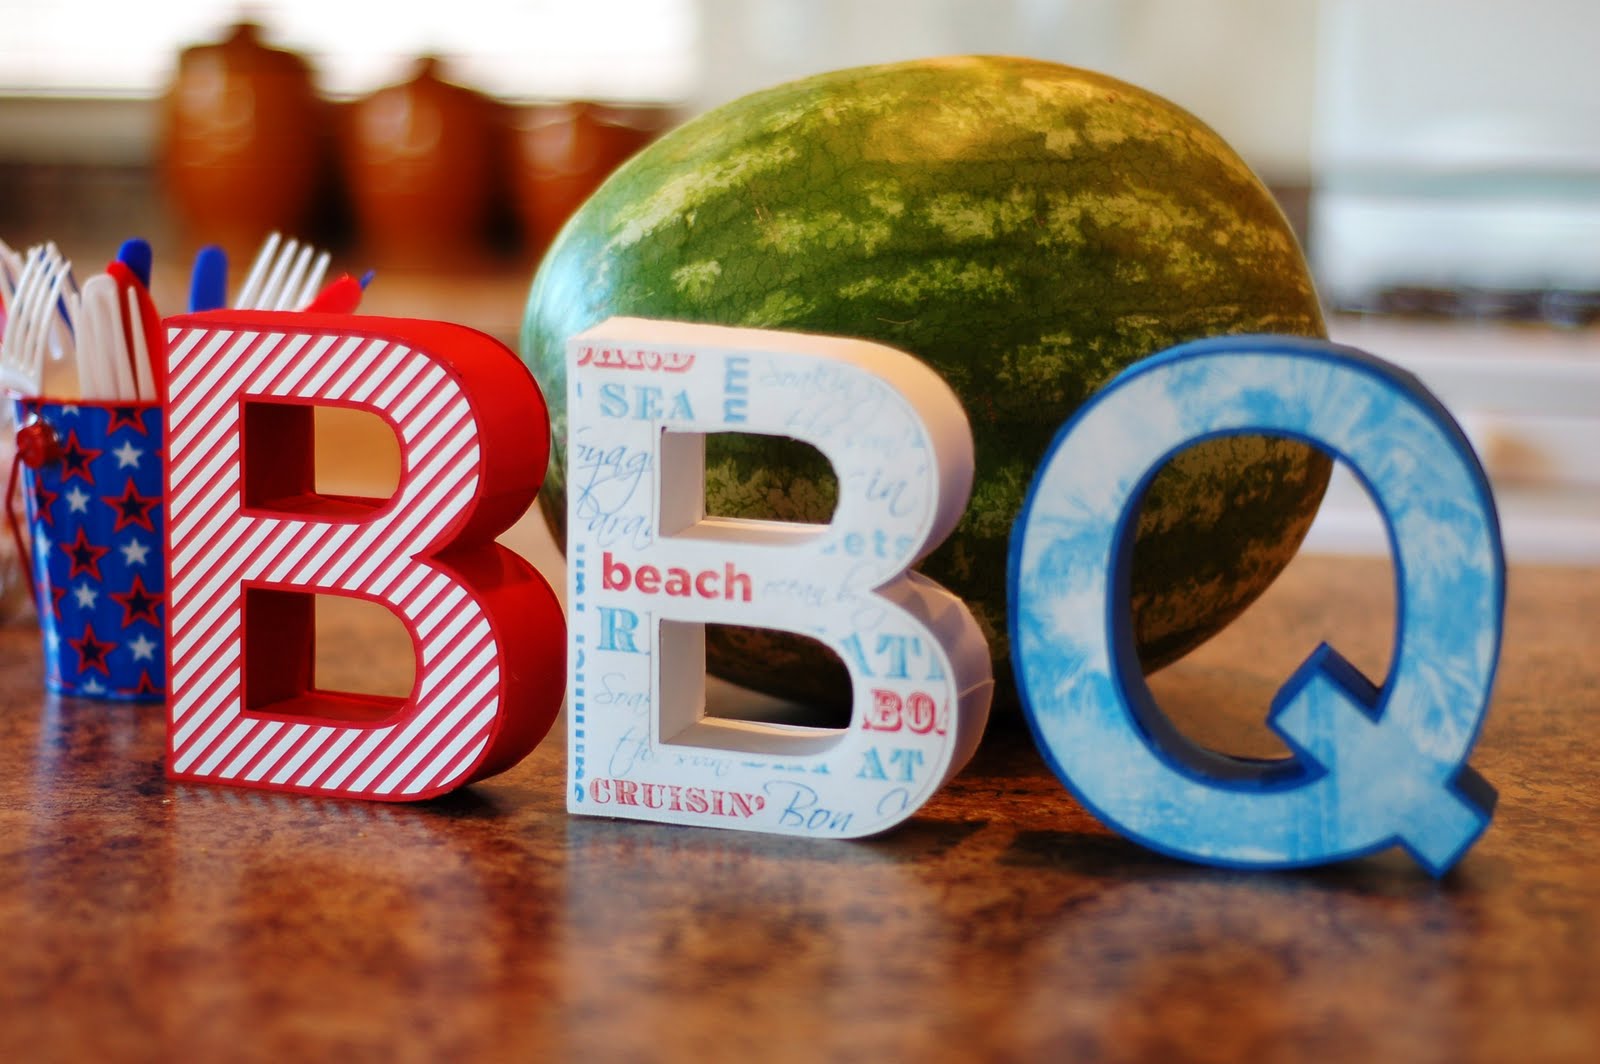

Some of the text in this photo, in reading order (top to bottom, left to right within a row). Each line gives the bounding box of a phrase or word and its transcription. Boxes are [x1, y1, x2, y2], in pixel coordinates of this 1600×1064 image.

[599, 381, 695, 421] SEA
[602, 551, 754, 603] beach
[855, 745, 924, 783] AT
[763, 779, 855, 833] Bon
